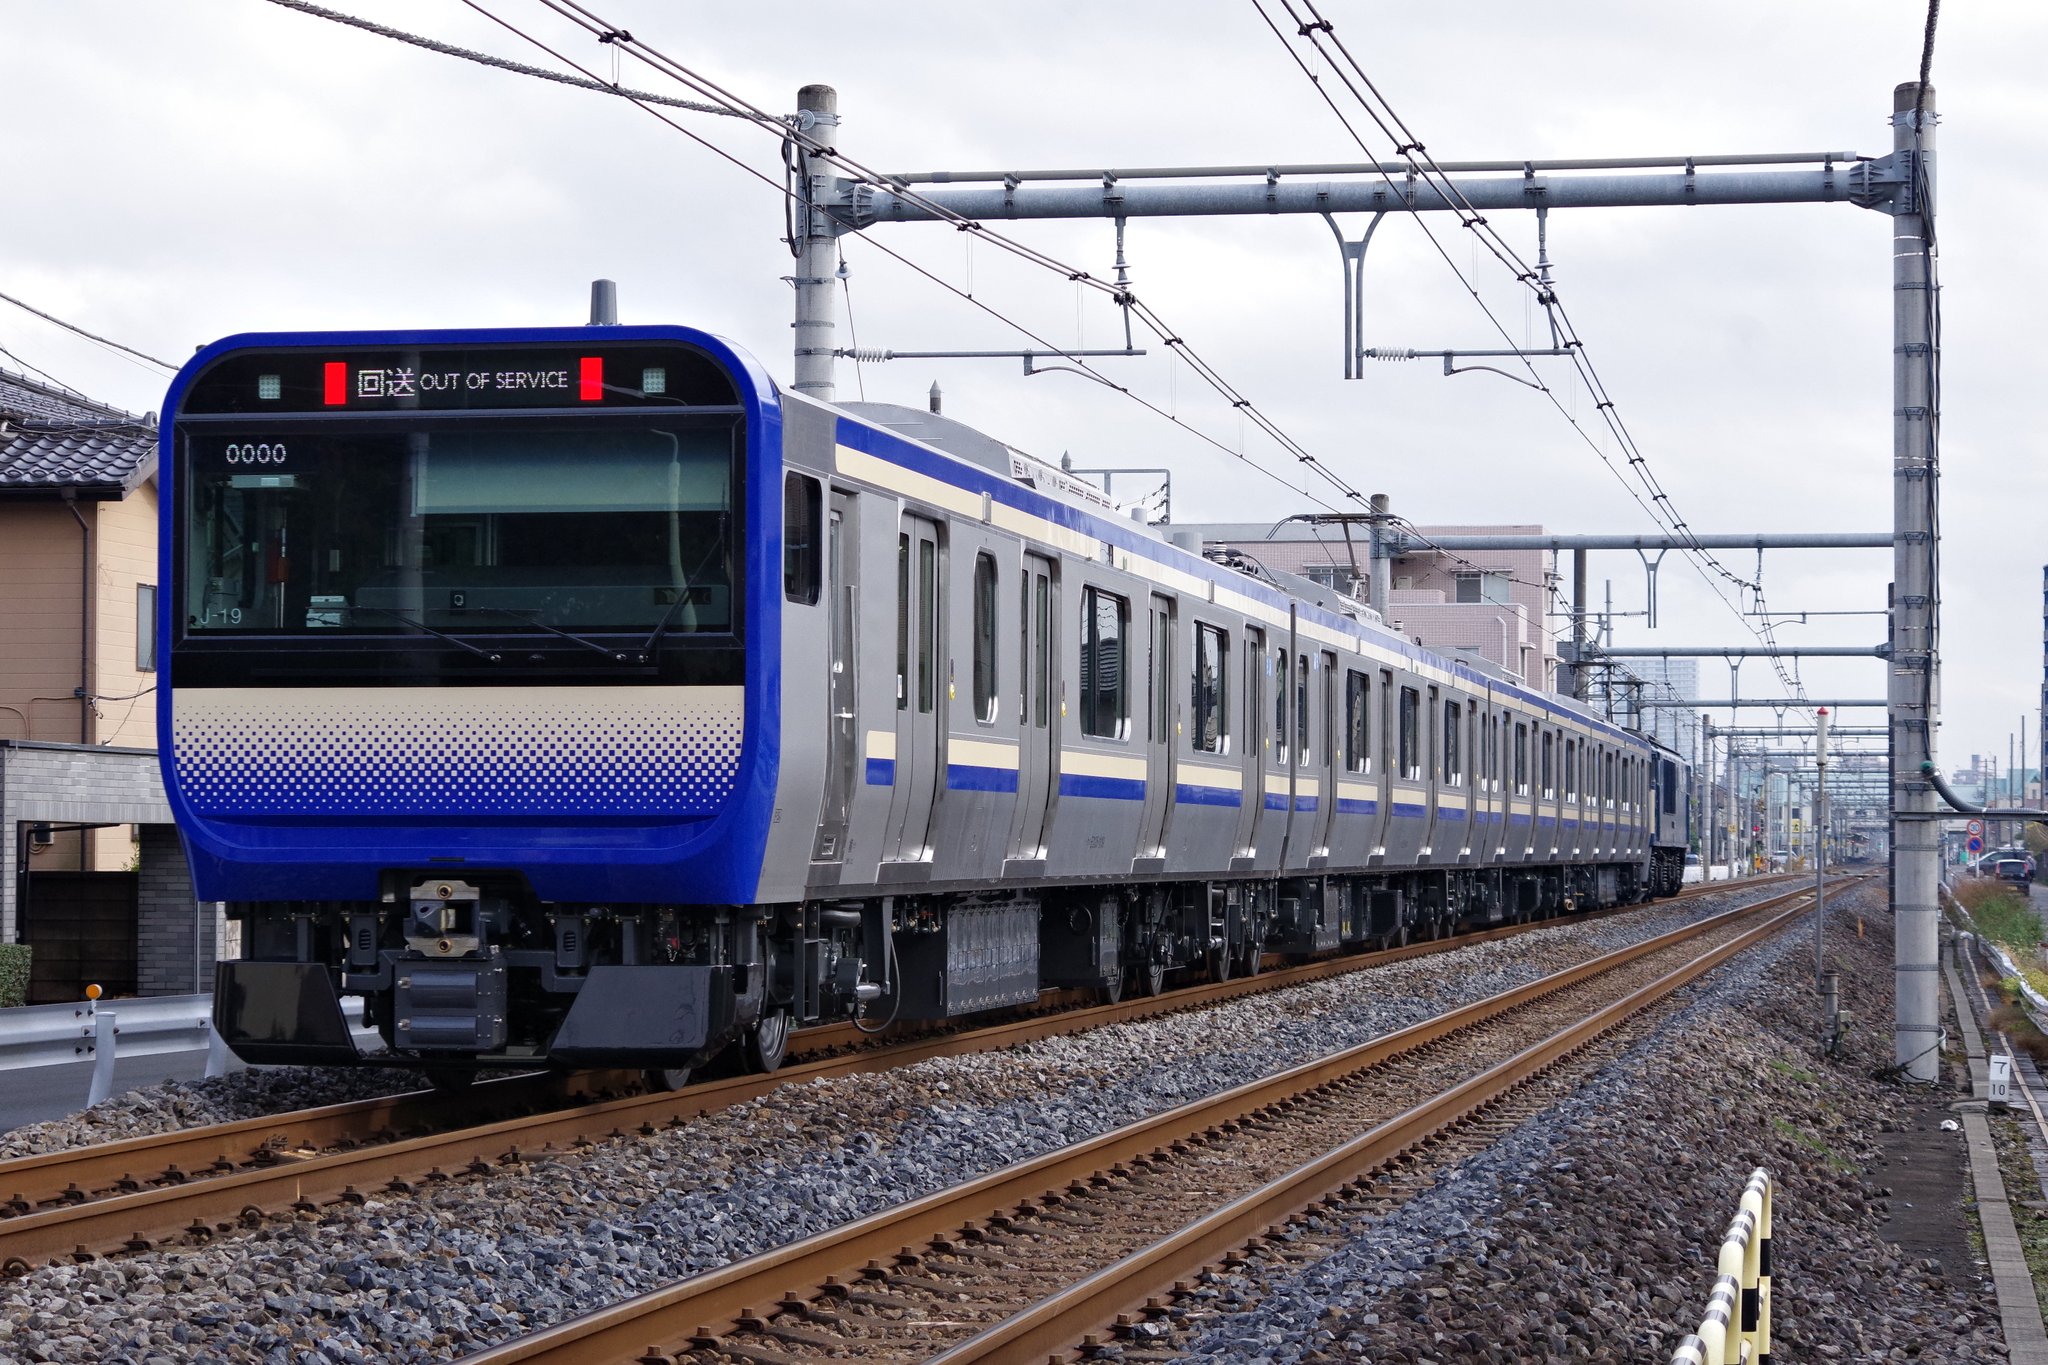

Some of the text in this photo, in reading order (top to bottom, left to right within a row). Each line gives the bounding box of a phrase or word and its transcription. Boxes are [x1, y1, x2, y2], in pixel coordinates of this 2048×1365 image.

[358, 367, 568, 397] 回送 OUT OF SERVICE
[226, 443, 287, 464] 0000
[200, 607, 242, 624] J-19
[1993, 1061, 2008, 1075] 7
[1992, 1083, 2006, 1096] 10
